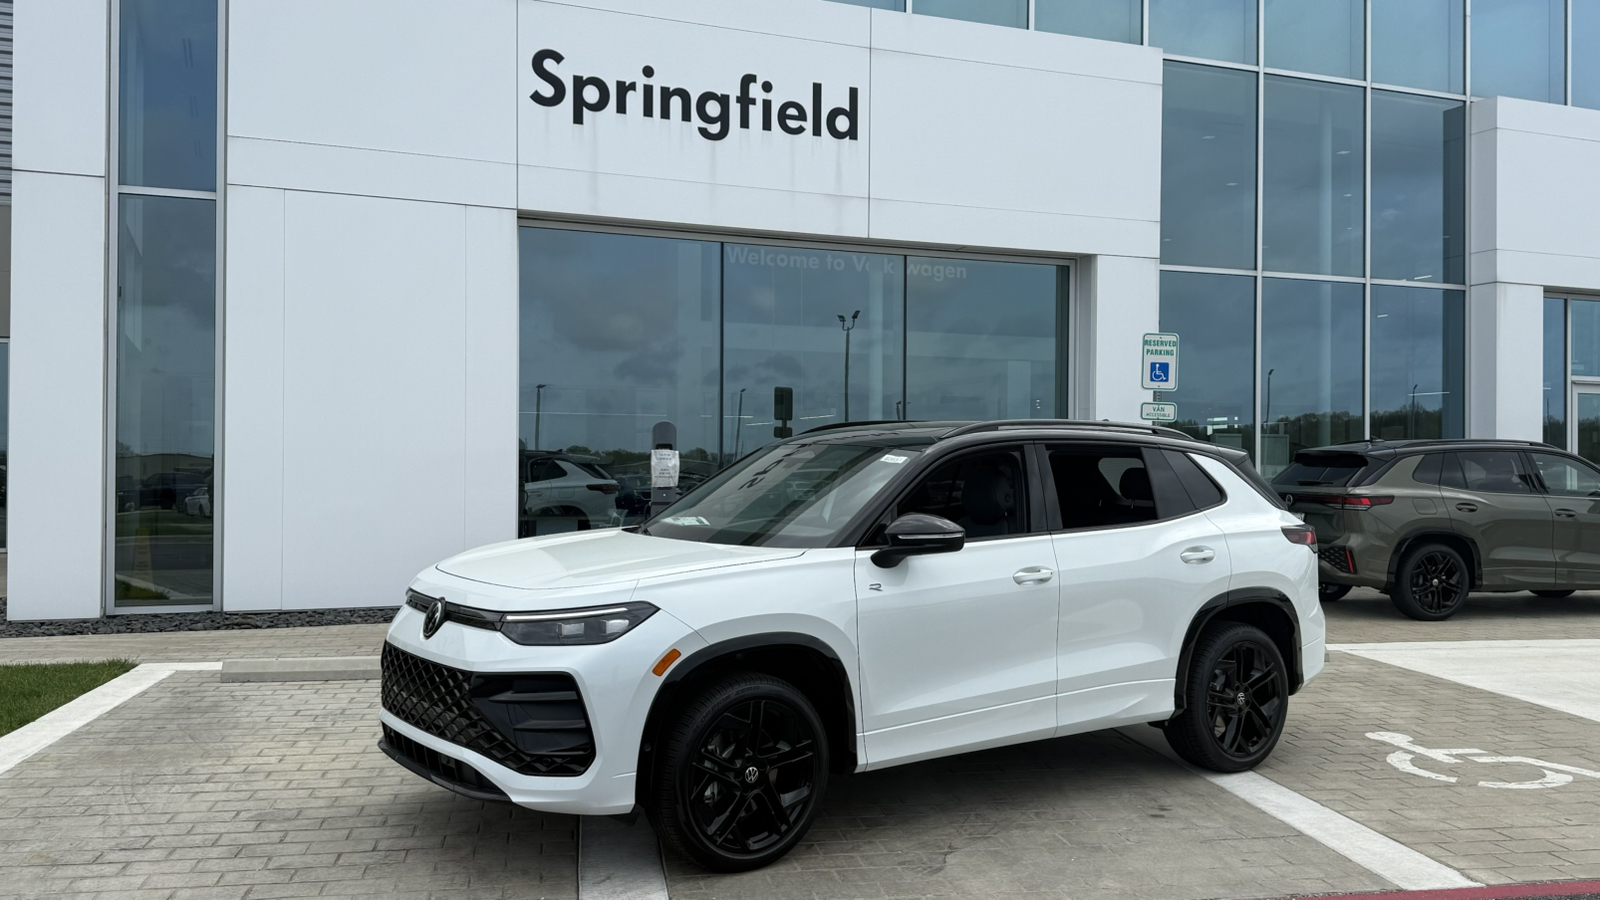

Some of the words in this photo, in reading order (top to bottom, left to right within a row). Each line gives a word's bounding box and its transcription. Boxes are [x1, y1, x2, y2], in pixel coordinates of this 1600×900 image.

[529, 48, 859, 141] Springfield
[726, 246, 820, 270] Welcome
[825, 254, 846, 271] to
[692, 694, 732, 734] SCORPION
[734, 685, 760, 697] ZERO
